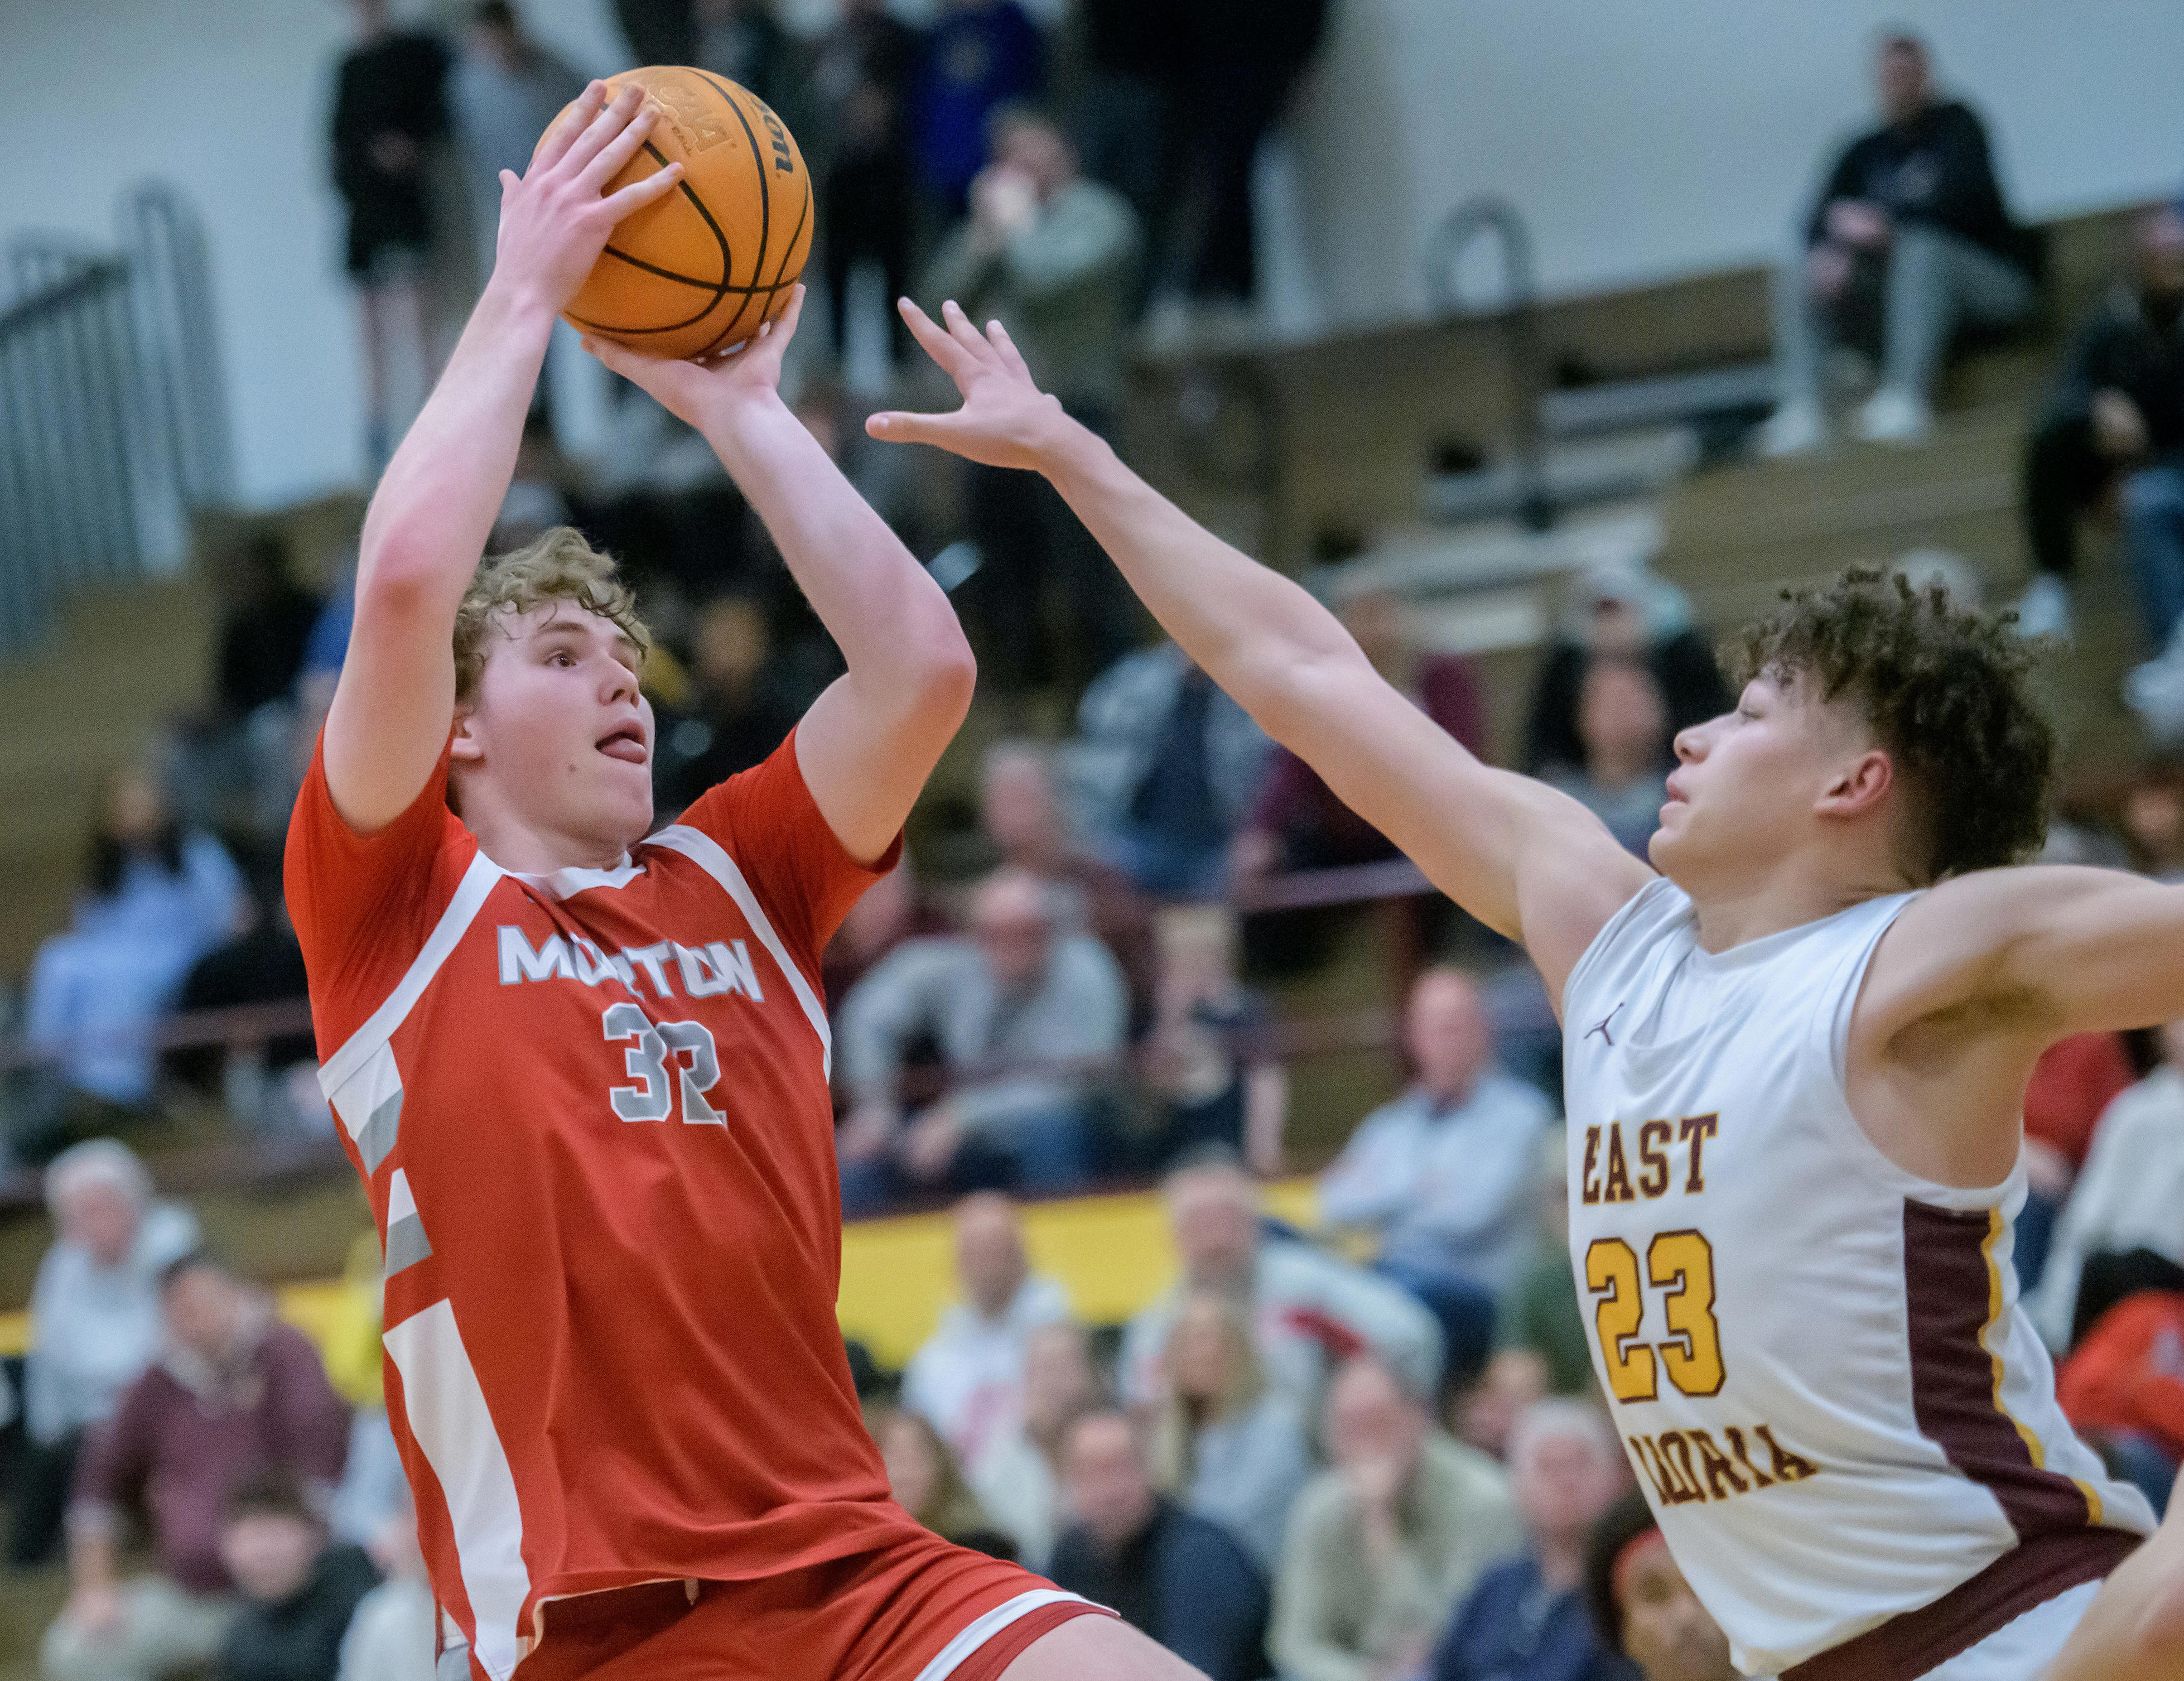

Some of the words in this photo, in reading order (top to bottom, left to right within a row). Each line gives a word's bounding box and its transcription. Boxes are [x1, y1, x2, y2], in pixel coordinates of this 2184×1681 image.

[602, 1003, 727, 1128] 32
[1582, 1111, 1719, 1205] EAST
[1585, 1229, 1726, 1404] 23
